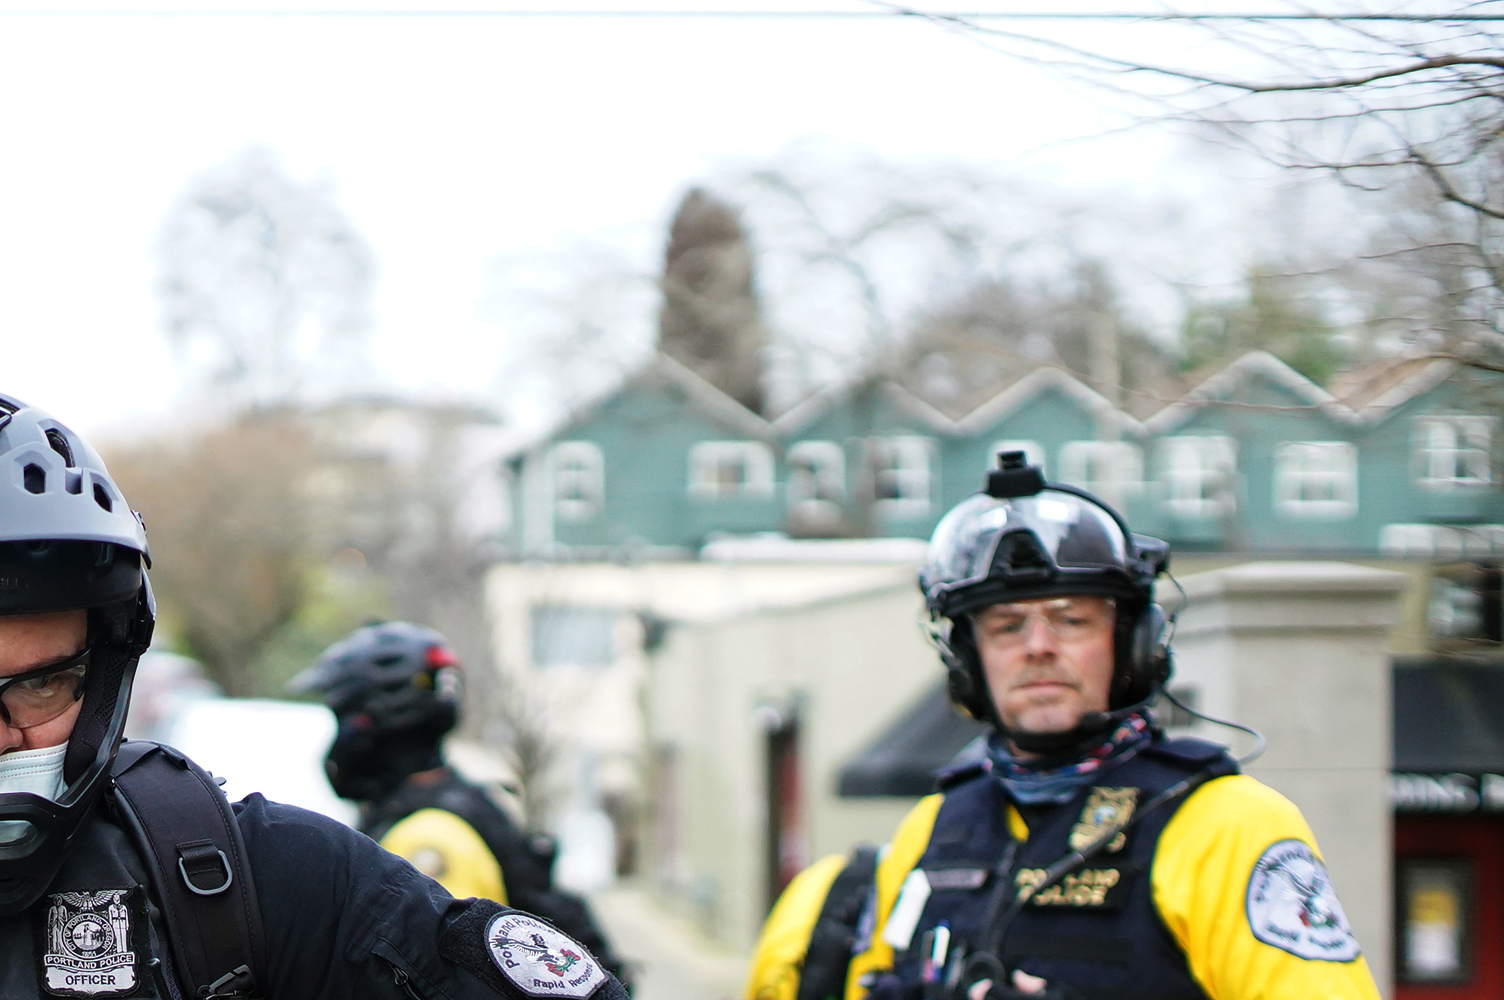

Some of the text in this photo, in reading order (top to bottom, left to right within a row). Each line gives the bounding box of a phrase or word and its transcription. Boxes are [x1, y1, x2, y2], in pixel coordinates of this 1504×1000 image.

[48, 954, 132, 969] PORTLAND POLICE
[65, 974, 116, 986] OFFICER
[533, 978, 566, 990] Rapid
